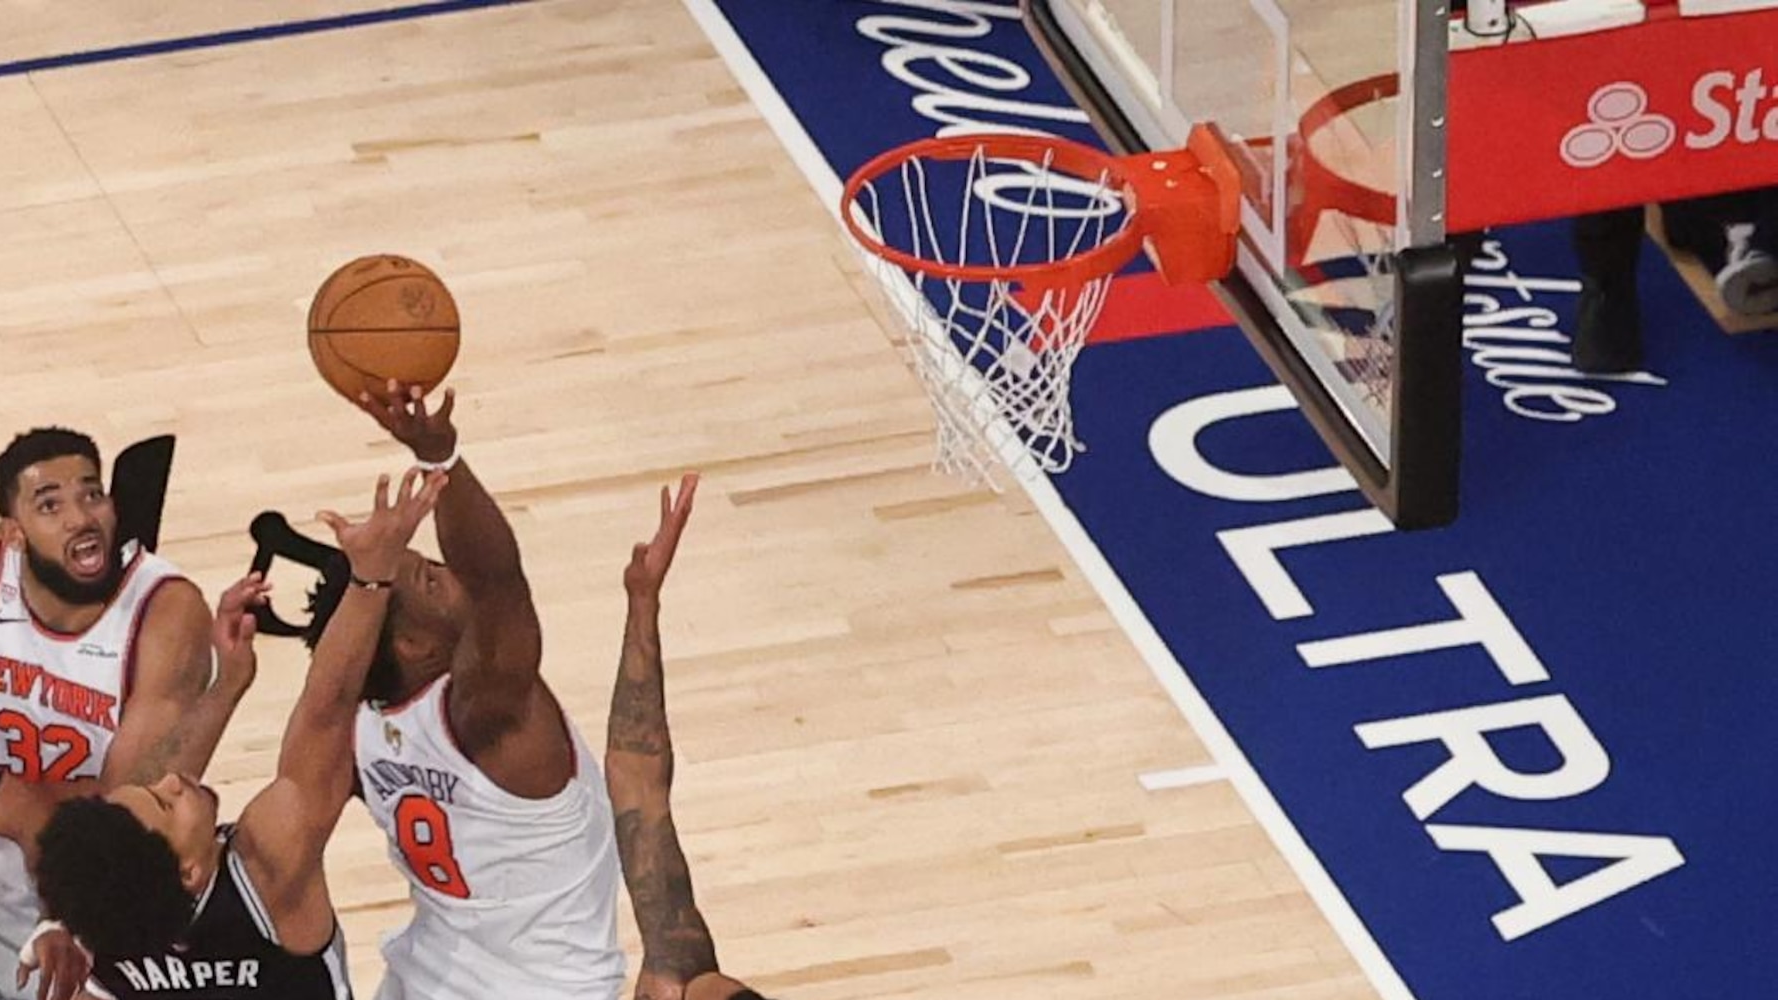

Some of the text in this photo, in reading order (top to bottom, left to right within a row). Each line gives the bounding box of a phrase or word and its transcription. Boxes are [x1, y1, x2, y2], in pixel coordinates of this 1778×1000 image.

[41, 672, 117, 732] YORK
[1148, 384, 1686, 942] ULTRA
[394, 794, 470, 899] 8
[115, 954, 260, 991] HARPER
